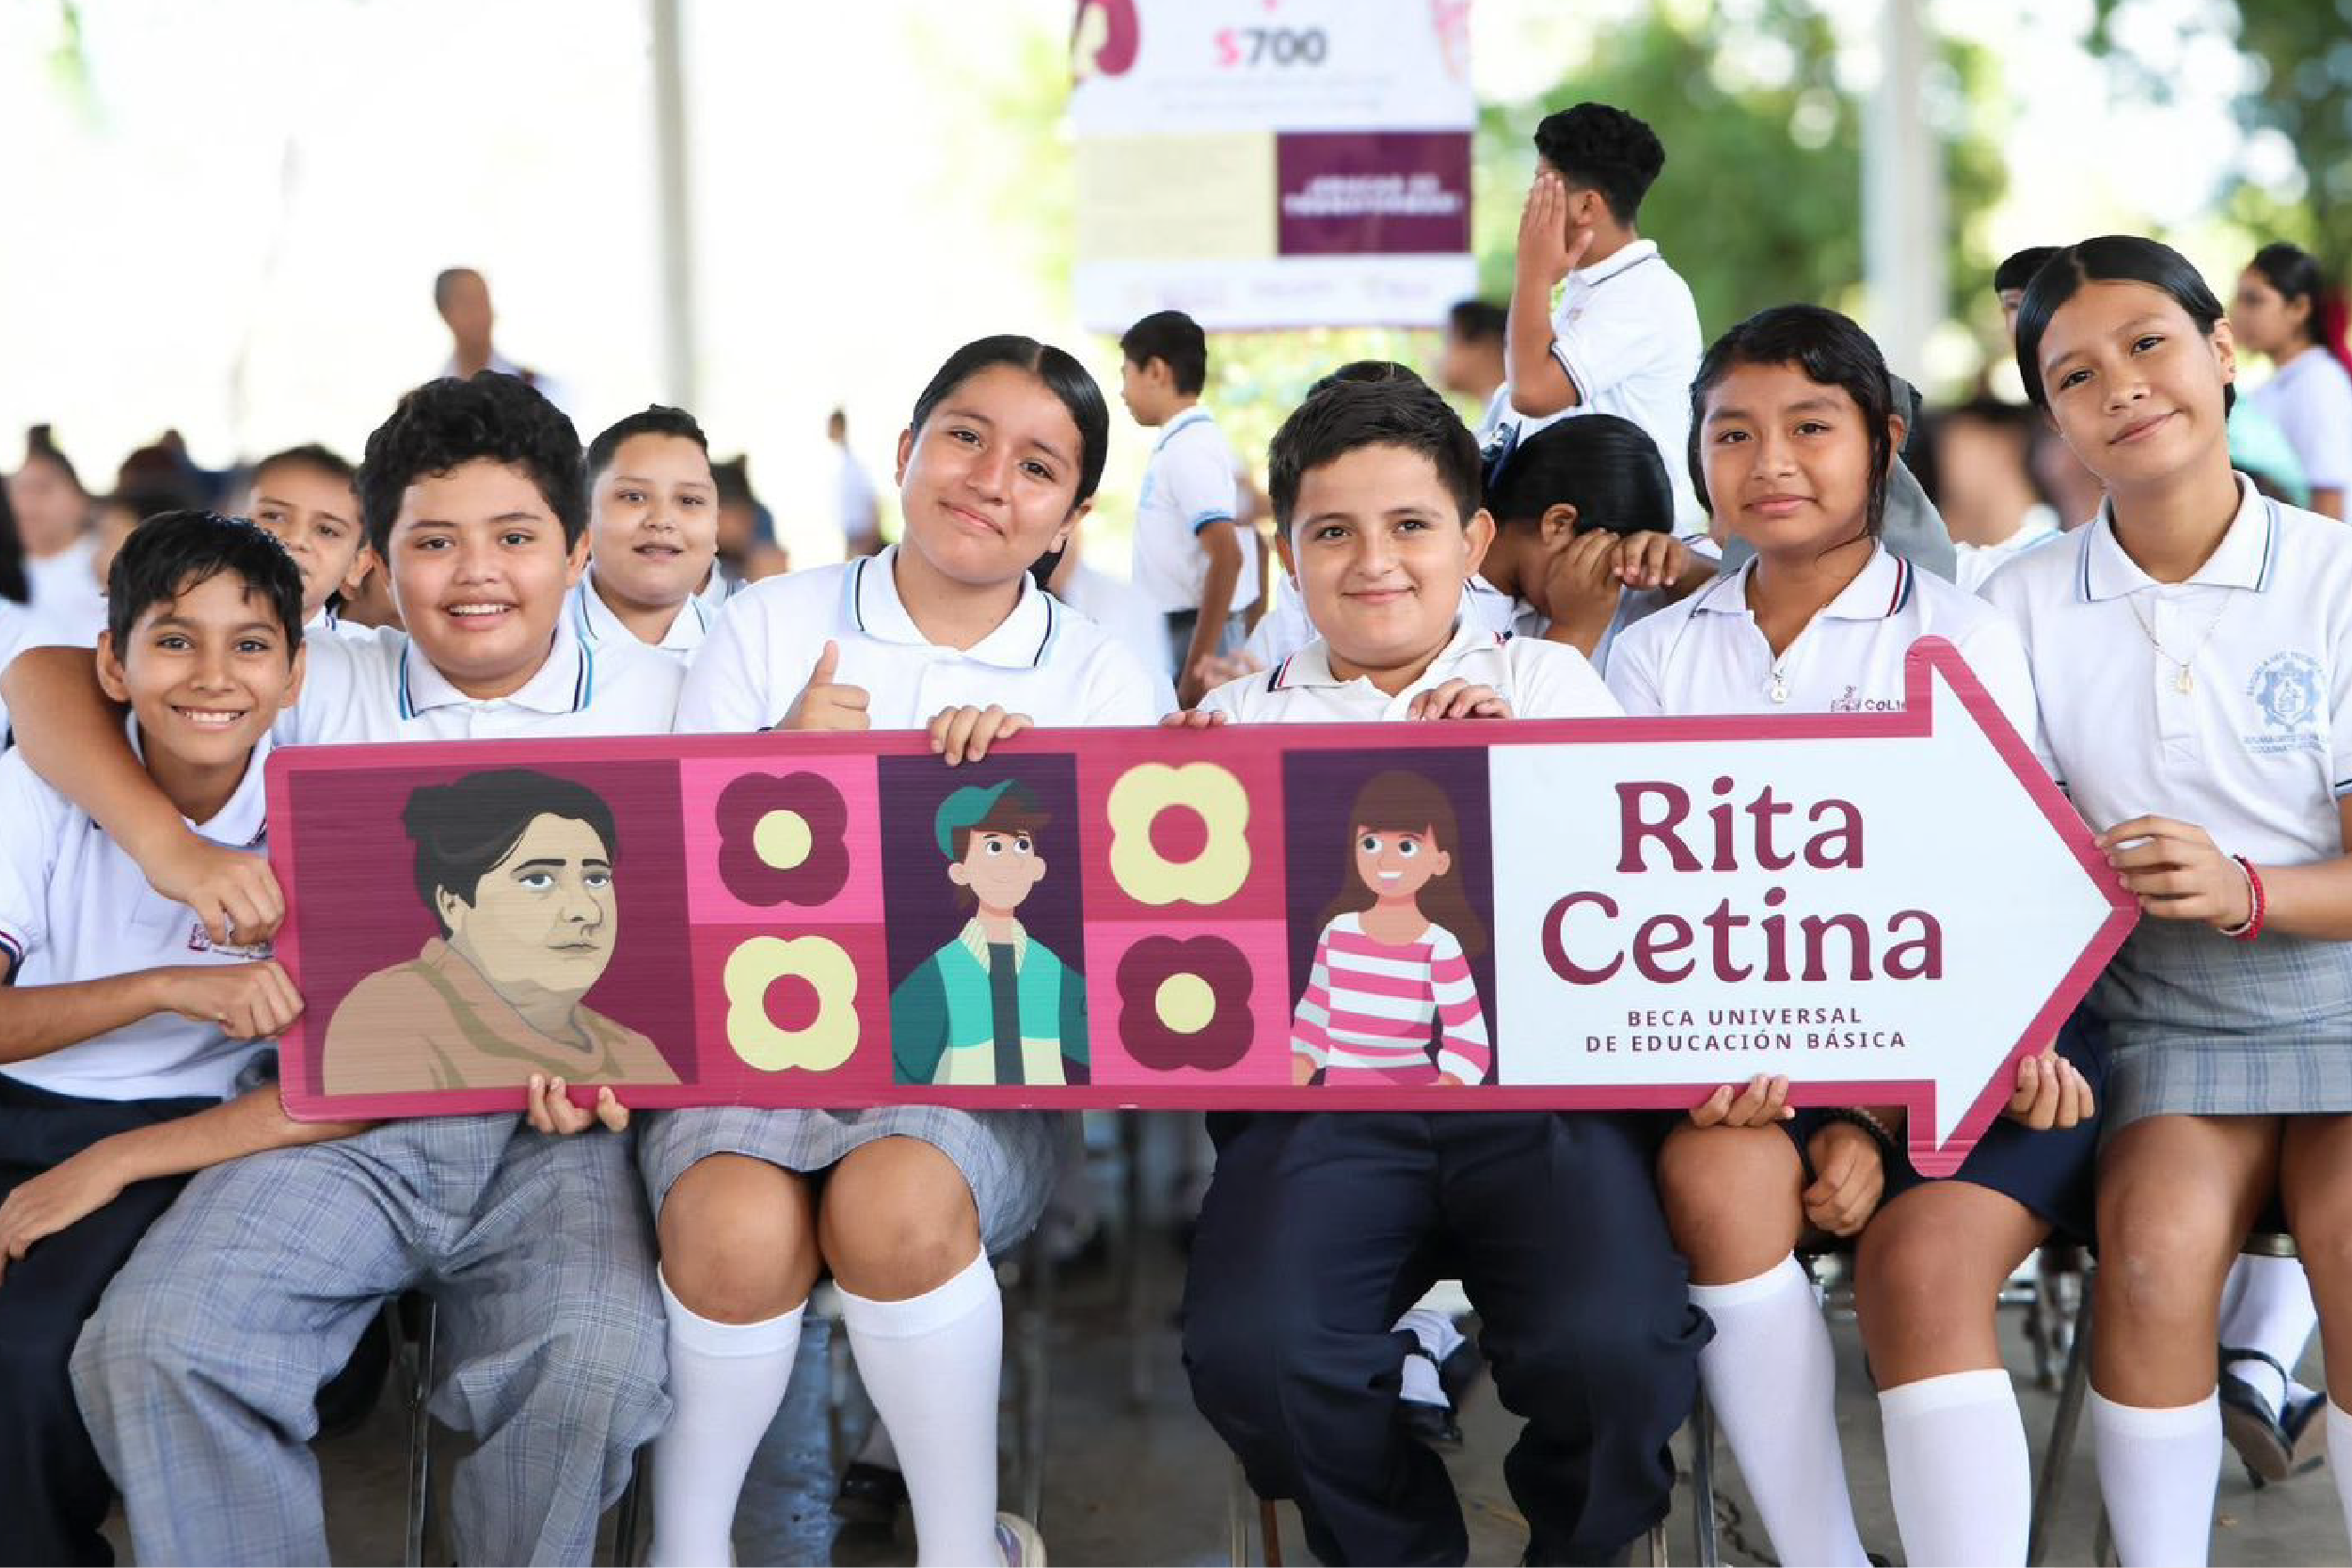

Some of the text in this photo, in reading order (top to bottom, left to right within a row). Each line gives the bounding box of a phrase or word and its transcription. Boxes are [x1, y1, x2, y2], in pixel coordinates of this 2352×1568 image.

[1615, 776, 1864, 875] Rita
[1541, 886, 1943, 986] Cetina
[1586, 1027, 1906, 1053] DE EDUCACIÓN BÁSICA
[1628, 1007, 1862, 1027] BECA UNIVERSAL
